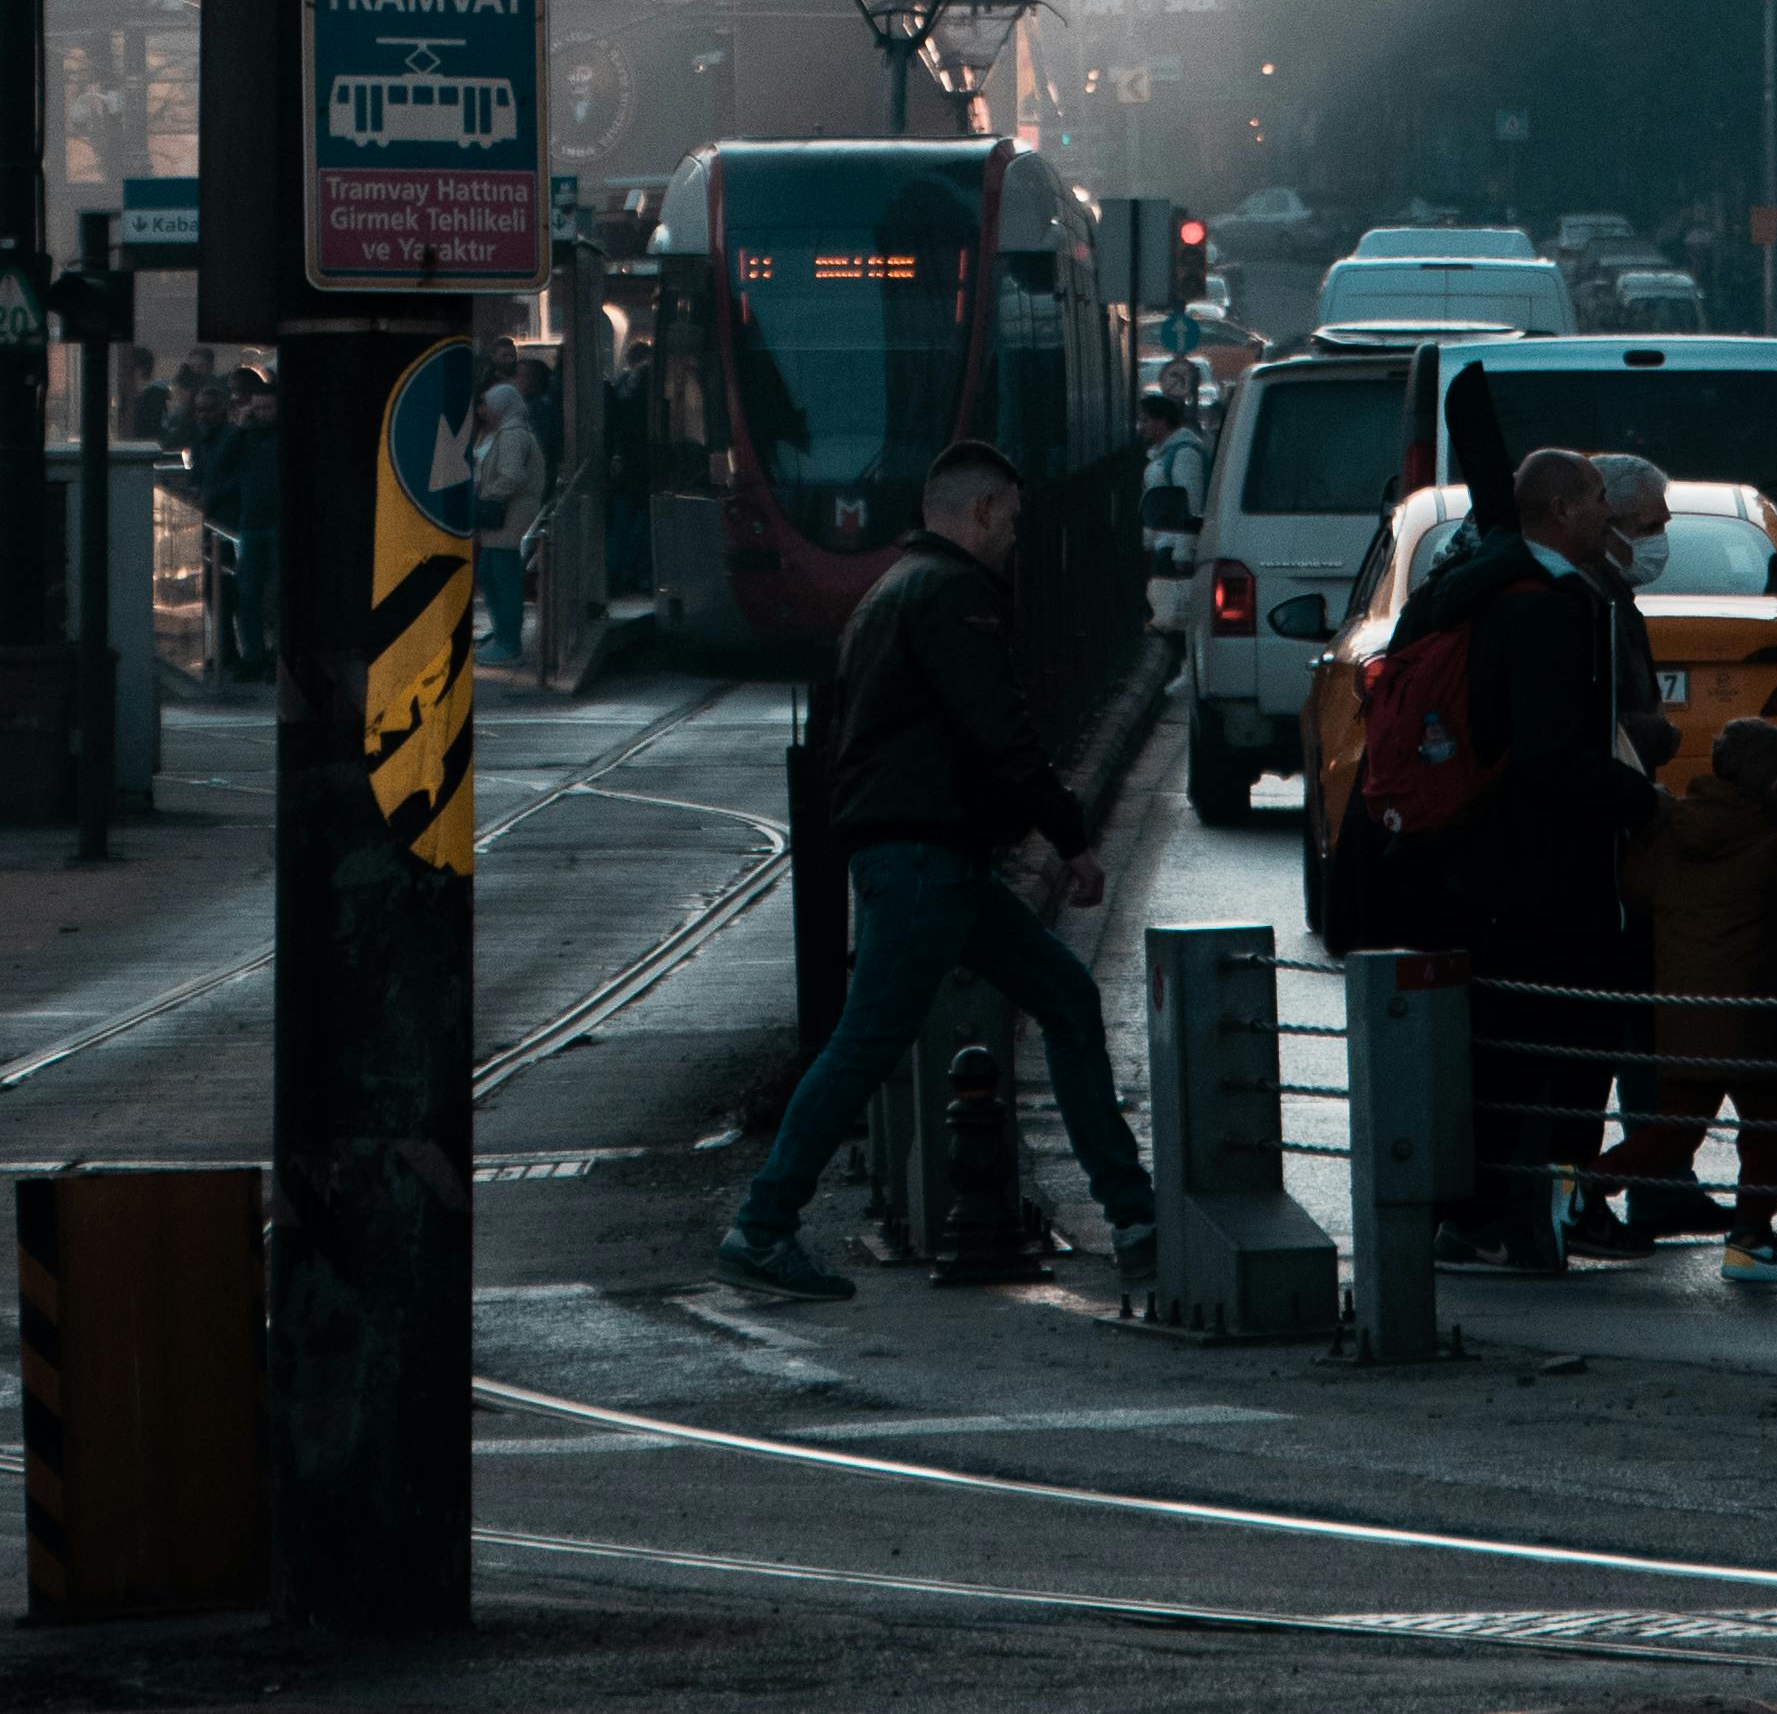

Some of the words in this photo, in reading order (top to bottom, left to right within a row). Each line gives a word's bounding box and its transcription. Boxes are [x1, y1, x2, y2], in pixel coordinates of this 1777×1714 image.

[326, 175, 430, 207] Tramvay
[437, 178, 530, 204] Hattına
[330, 206, 419, 231] Girmek
[427, 207, 528, 233] Tehlikeli
[362, 241, 389, 260] ve
[398, 237, 497, 263] Yaaktır
[1664, 674, 1677, 700] 7
